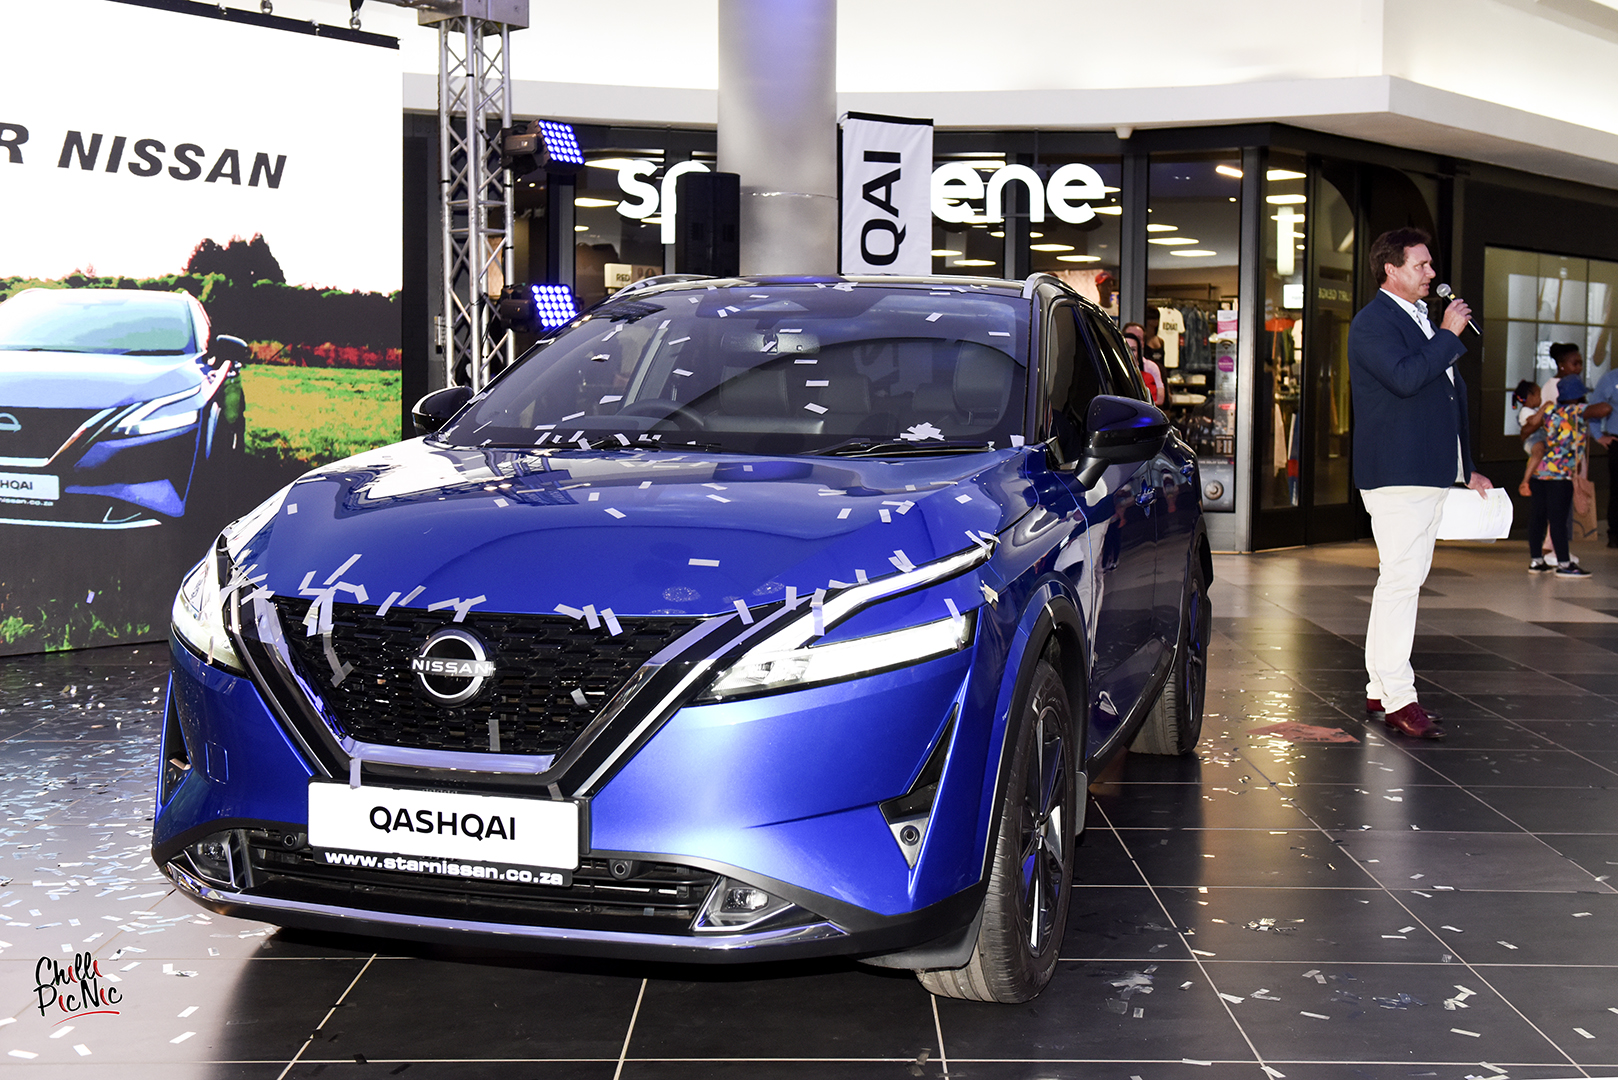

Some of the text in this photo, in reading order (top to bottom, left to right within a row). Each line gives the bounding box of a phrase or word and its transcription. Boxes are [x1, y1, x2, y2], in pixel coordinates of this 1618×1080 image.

[57, 130, 287, 189] NISSAN
[412, 659, 489, 674] NISSAN
[369, 805, 516, 841] QASHQAI
[324, 851, 563, 885] www.starnissan.co.za
